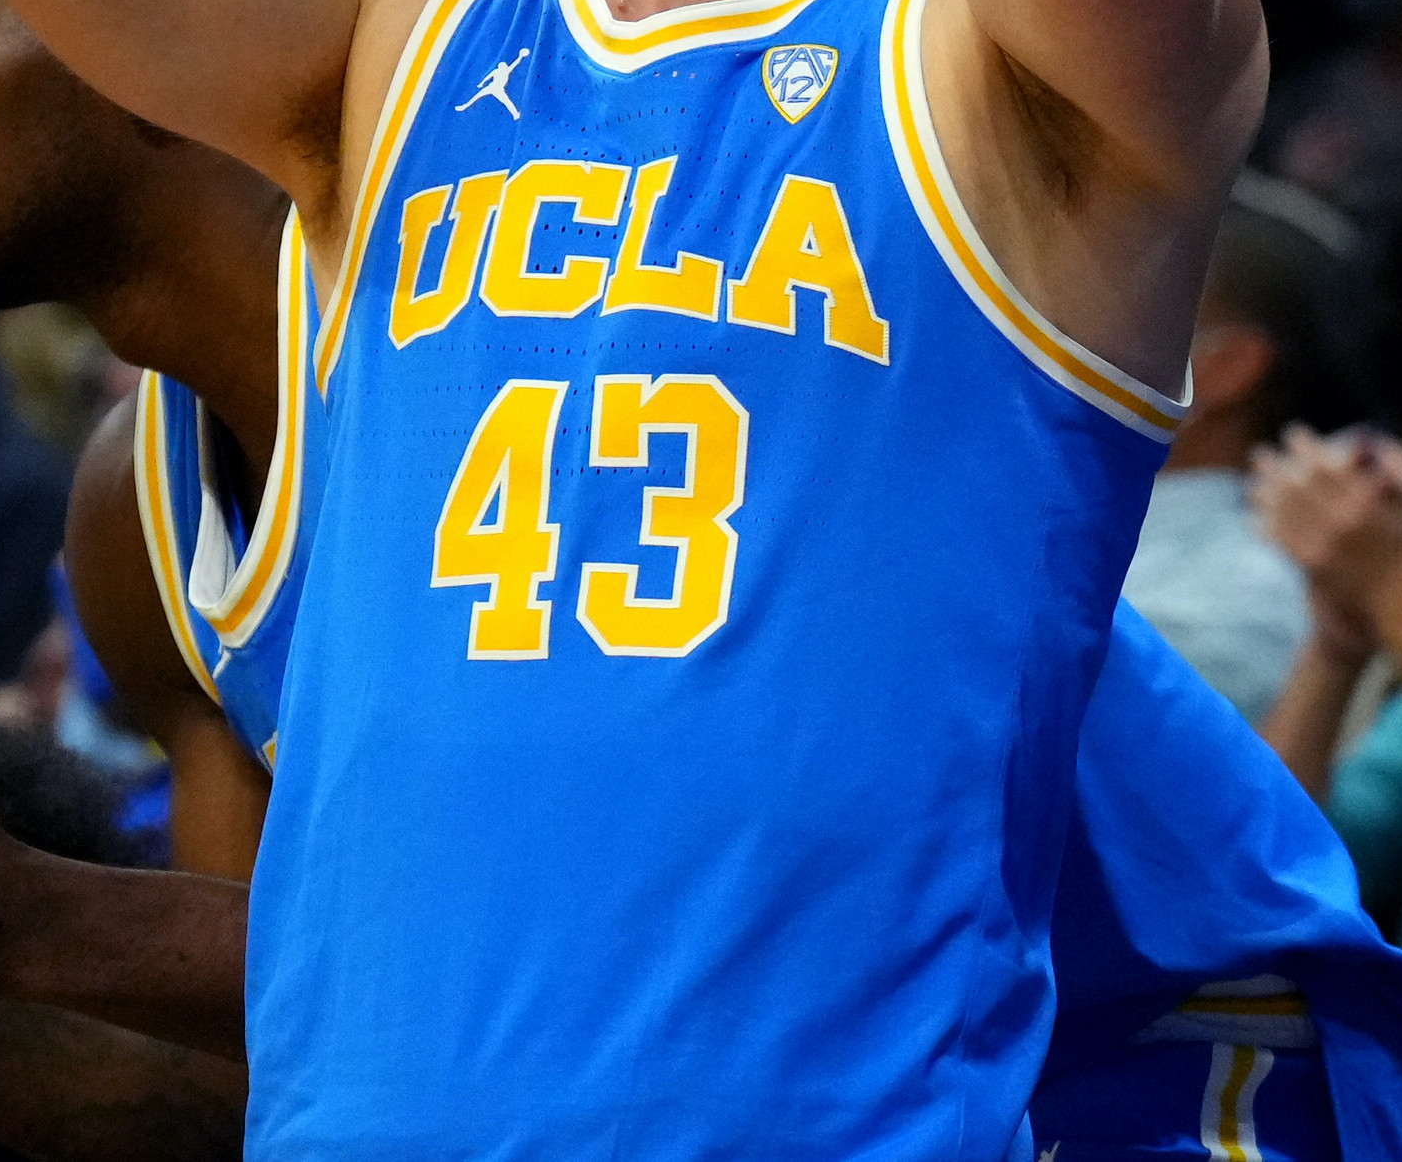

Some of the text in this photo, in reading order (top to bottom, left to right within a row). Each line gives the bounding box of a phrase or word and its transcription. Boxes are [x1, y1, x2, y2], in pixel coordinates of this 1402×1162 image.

[768, 47, 834, 89] PAC
[778, 75, 814, 104] 12
[388, 154, 891, 367] UCLA
[430, 373, 749, 662] 43
